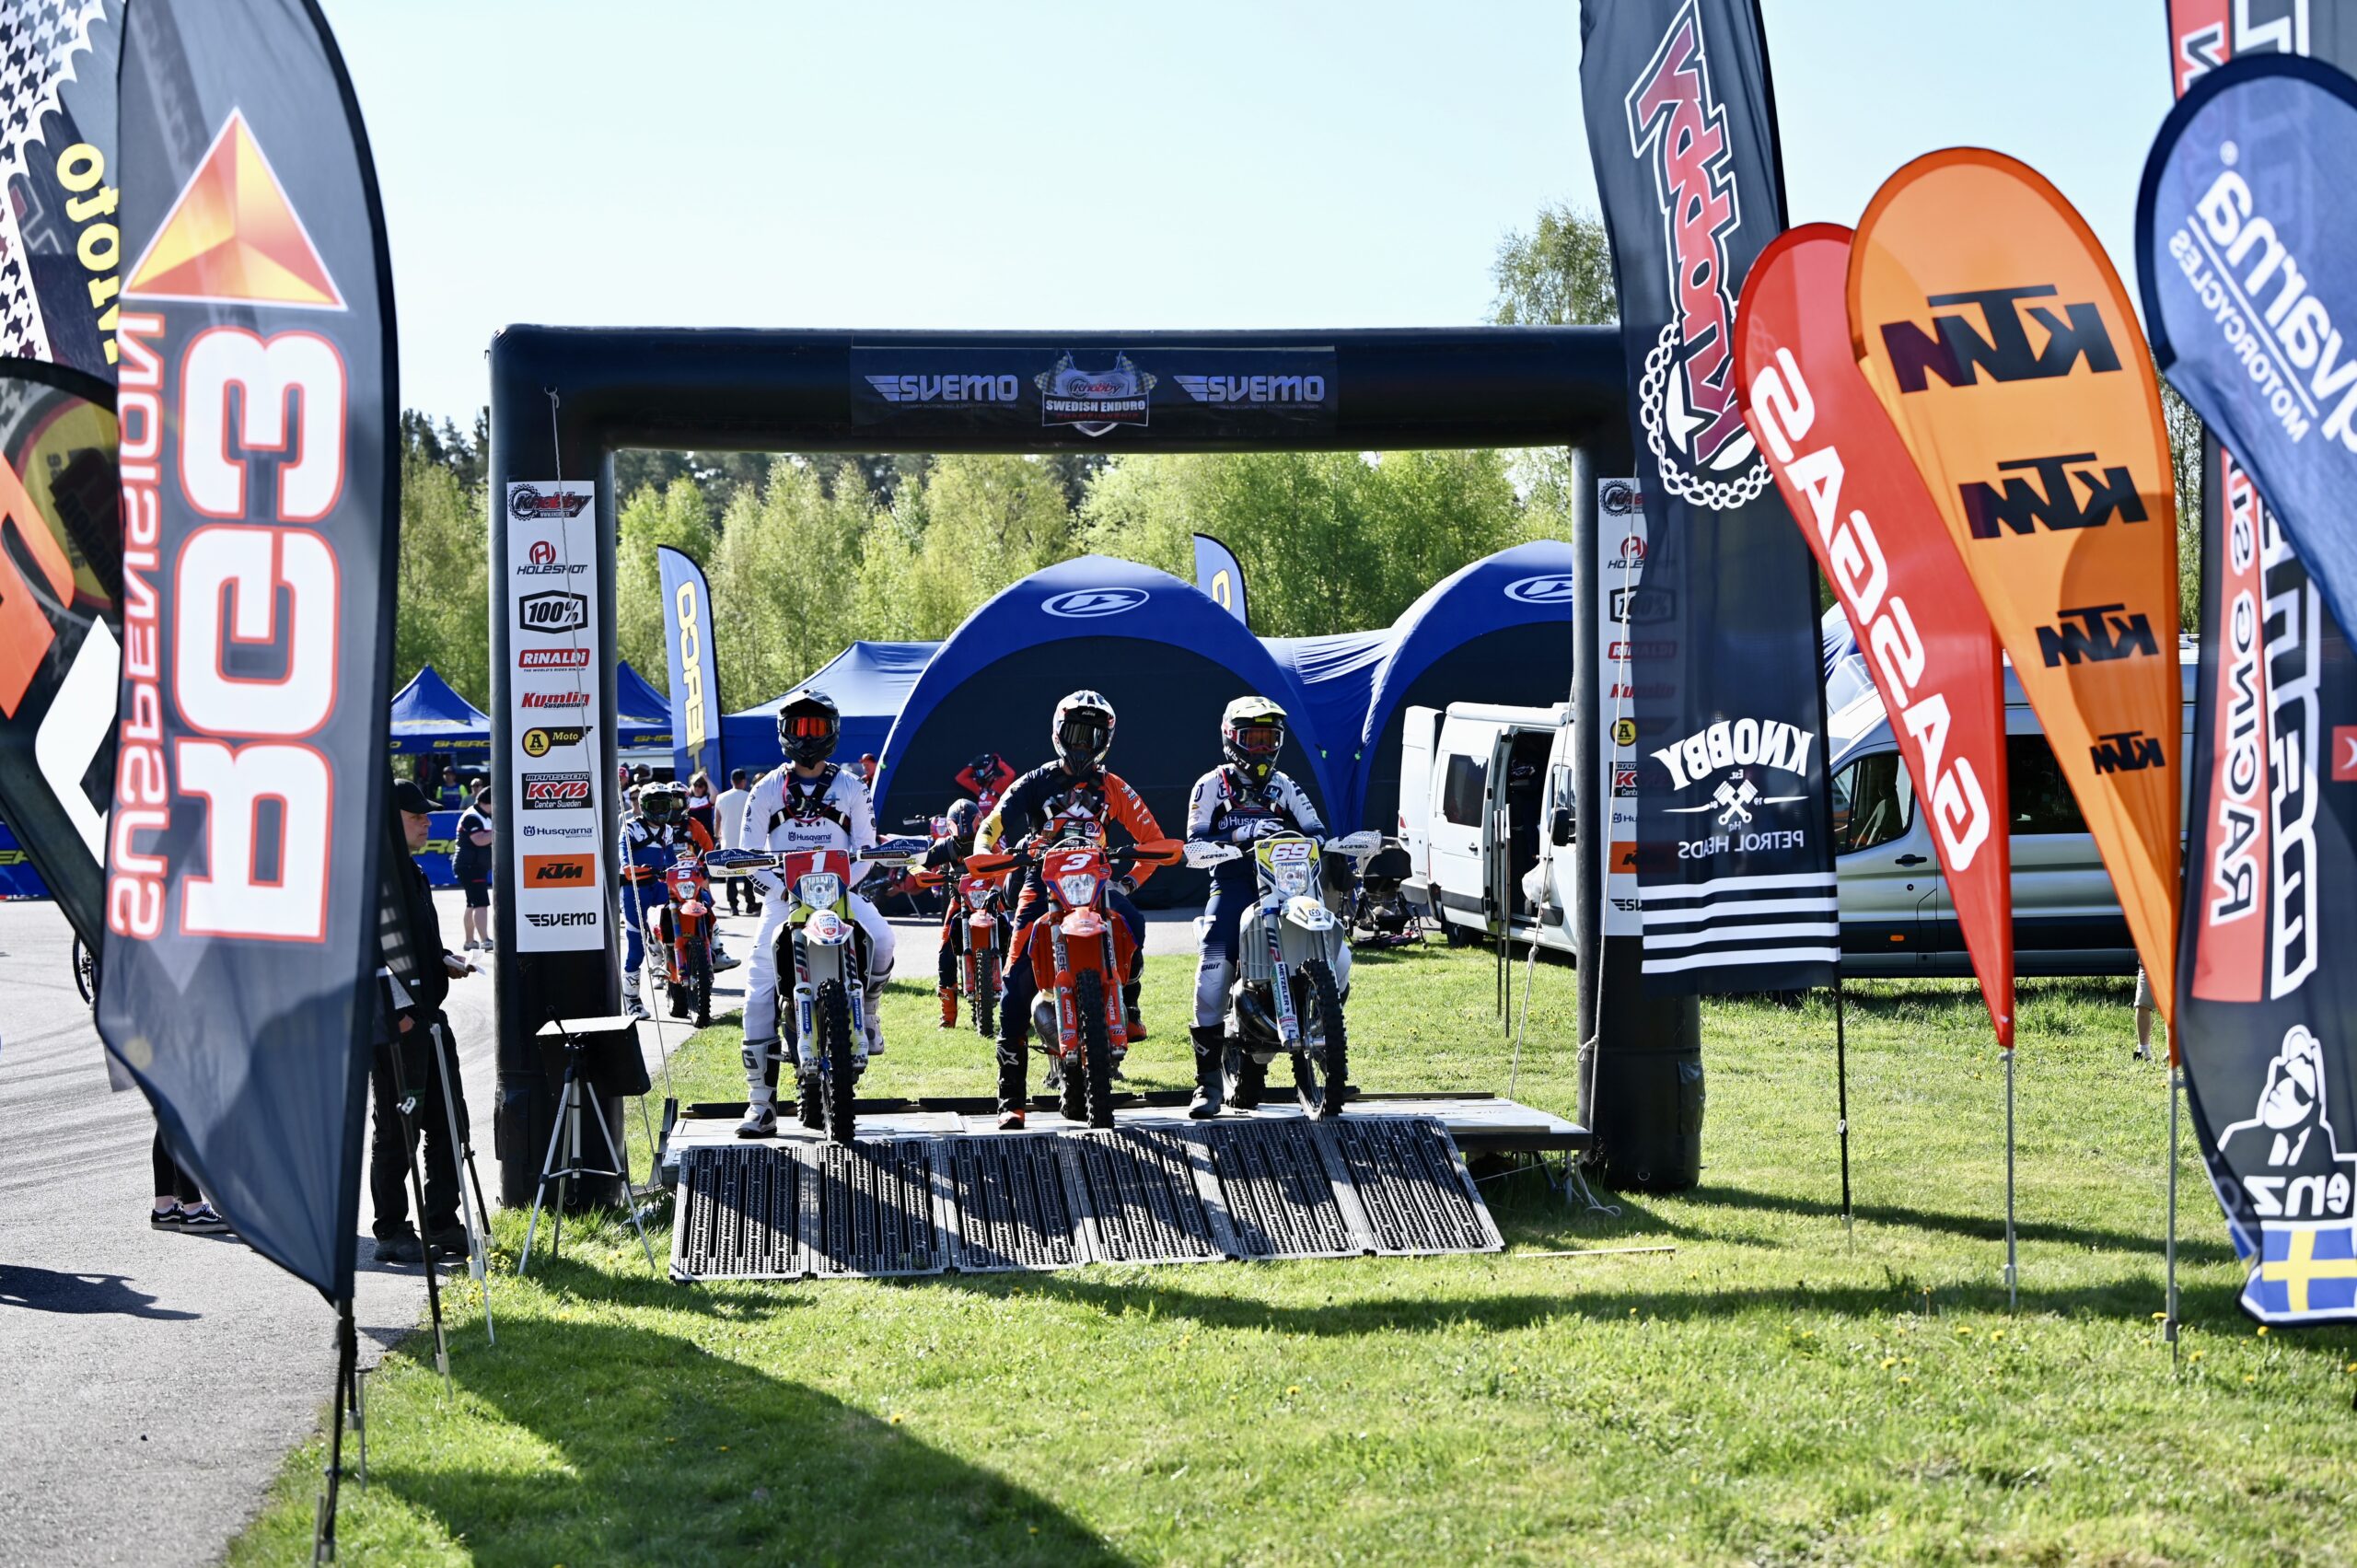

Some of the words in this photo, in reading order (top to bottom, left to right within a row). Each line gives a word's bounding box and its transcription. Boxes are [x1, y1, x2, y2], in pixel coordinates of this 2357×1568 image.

[900, 375, 1018, 401] SVEMO
[1208, 375, 1325, 402] SVEMO
[1046, 400, 1098, 412] SWEDISH
[1100, 400, 1146, 412] ENDURO
[528, 600, 579, 623] 100%
[521, 691, 590, 708] Kumlin
[543, 701, 586, 709] Suspension
[552, 731, 579, 740] Moto
[527, 782, 589, 800] KYB
[534, 800, 556, 808] Center
[557, 800, 582, 808] Sweden
[537, 827, 593, 837] Husqvarna
[796, 833, 831, 842] Husqvarna
[1270, 842, 1313, 863] 69
[810, 851, 827, 873] 1
[1060, 853, 1092, 872] 3
[536, 863, 583, 879] KTM
[677, 870, 691, 879] 5
[540, 912, 597, 927] SVEMO
[1277, 963, 1290, 1006] METZELER
